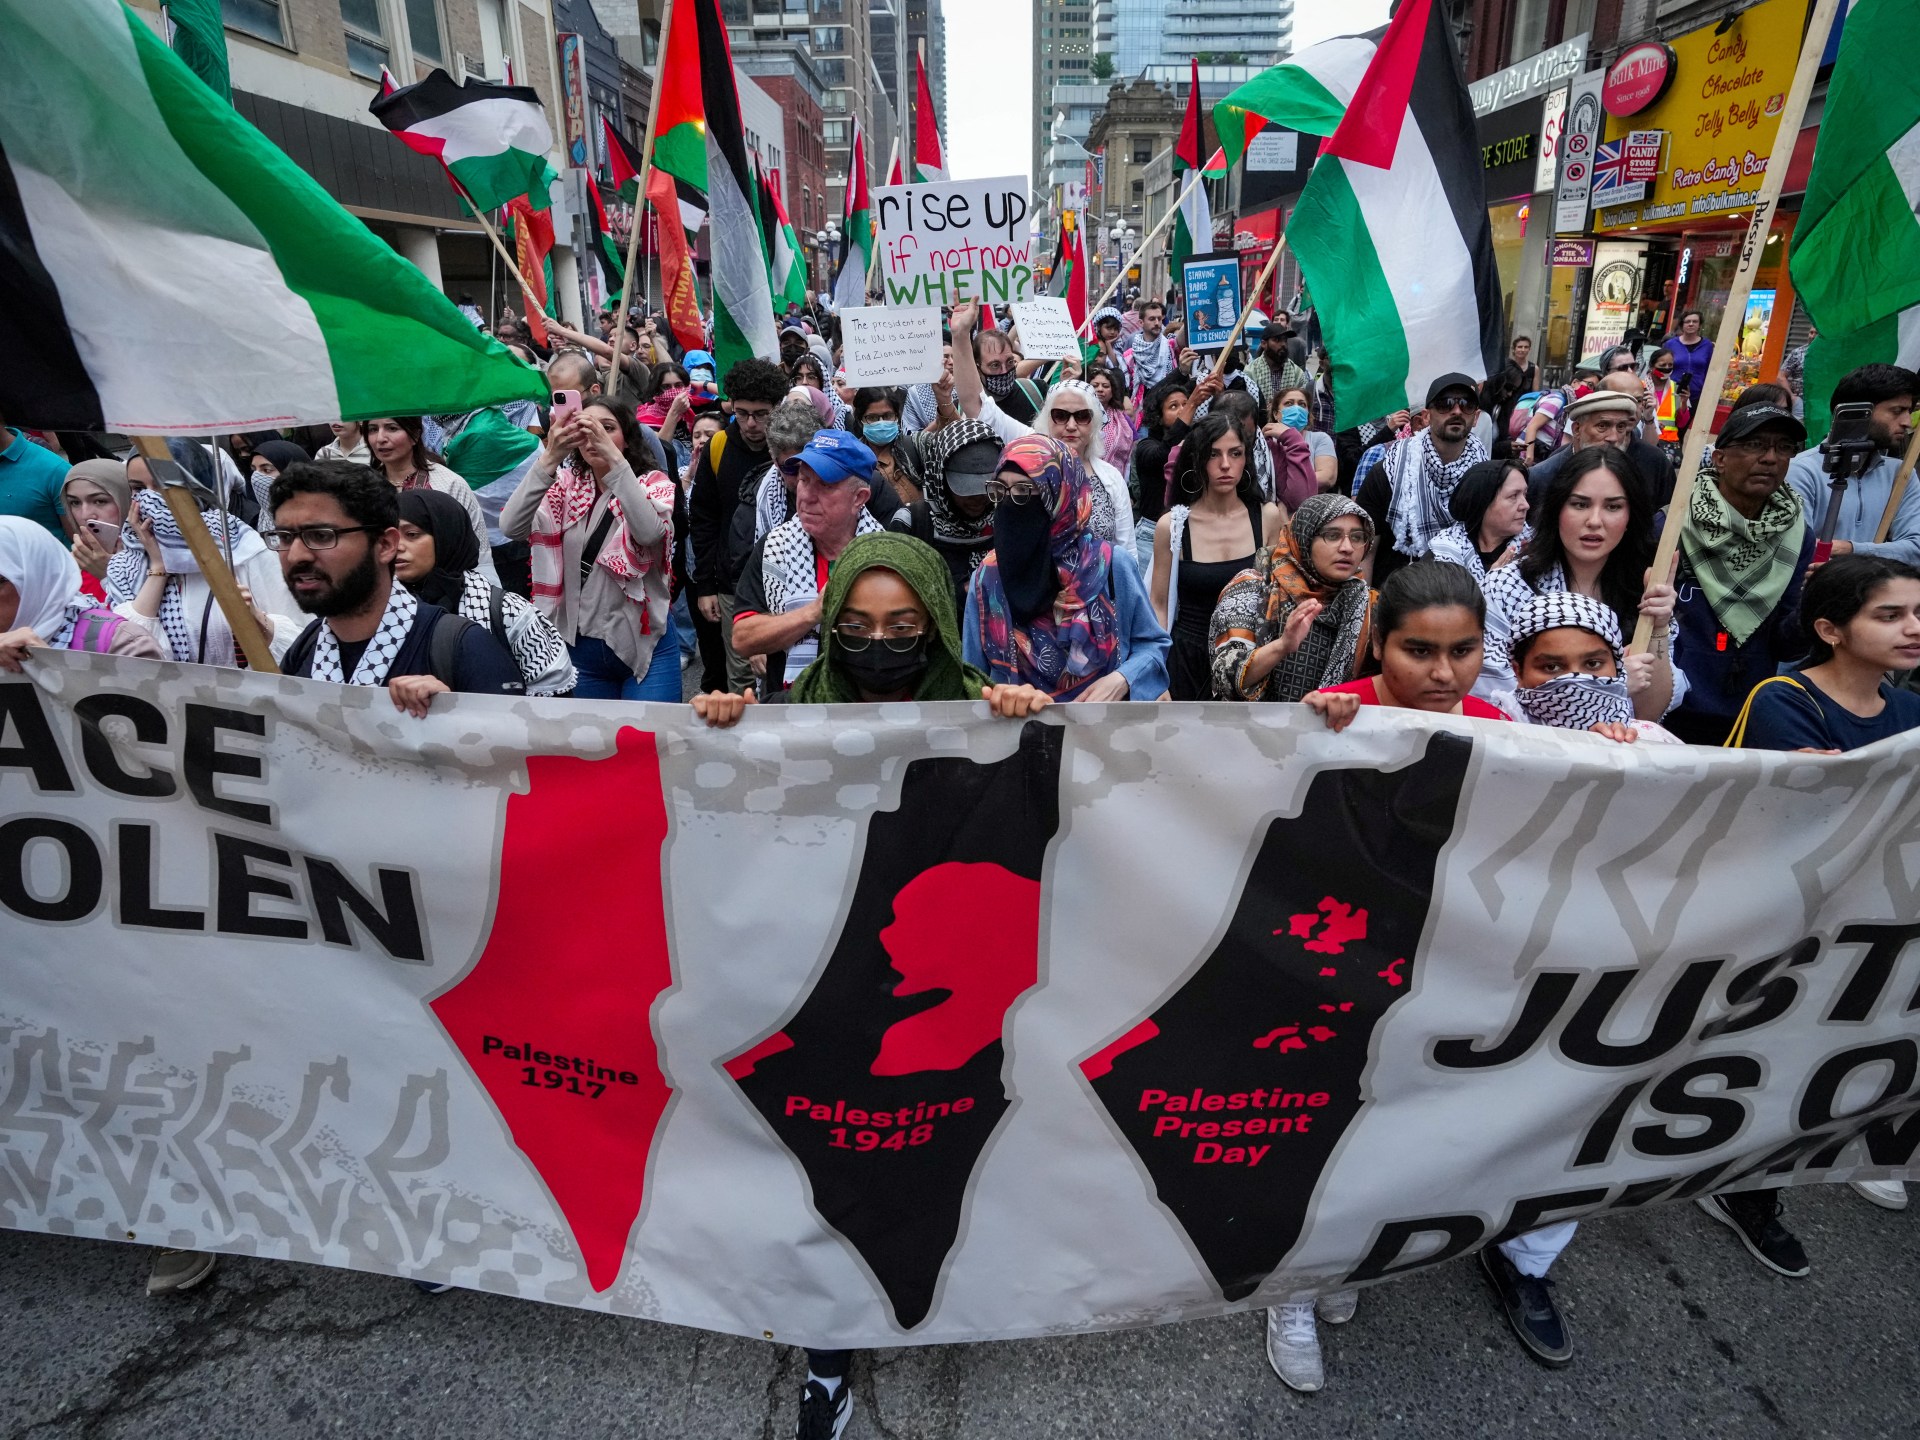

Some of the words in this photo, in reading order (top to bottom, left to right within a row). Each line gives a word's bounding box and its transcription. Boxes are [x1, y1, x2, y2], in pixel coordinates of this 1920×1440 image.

[1707, 34, 1748, 64] Candy
[1608, 66, 1635, 88] Bulk
[1639, 55, 1667, 77] Mine
[1702, 67, 1764, 99] Chocolate
[1616, 90, 1634, 104] Since
[1695, 111, 1724, 138] Jelly
[1728, 99, 1761, 129] Belly
[1494, 133, 1530, 166] STORE
[1629, 147, 1659, 158] CANDY
[1629, 159, 1657, 167] STORE
[1673, 168, 1700, 189] Retro
[1703, 158, 1741, 187] Candy
[878, 190, 970, 232] rise
[984, 192, 1027, 242] up
[1603, 212, 1617, 227] Shop
[1618, 210, 1638, 225] Online
[1642, 201, 1686, 221] bulkmine.com
[888, 234, 918, 274] if
[1121, 242, 1133, 251] 40
[1553, 242, 1586, 256] ONGHAIRS
[1187, 268, 1216, 281] STARVING
[1677, 248, 1690, 284] open
[886, 264, 1032, 306] WHEN?
[1188, 281, 1208, 292] BABIES
[851, 318, 868, 331] The
[872, 318, 914, 332] president
[854, 335, 867, 344] the
[870, 334, 885, 344] UN
[854, 350, 871, 361] End
[873, 349, 907, 360] Zionism
[909, 346, 927, 354] now!
[1583, 336, 1624, 354] LONGHA
[857, 366, 900, 377] Ceasefire
[903, 362, 924, 372] now!
[0, 682, 271, 826] ACE
[0, 817, 425, 961] OLEN
[1432, 923, 1920, 1068] JUST
[481, 1034, 641, 1086] Palestine
[520, 1065, 607, 1100] 1917
[784, 1094, 976, 1130] Palestine
[1137, 1087, 1331, 1114] Palestine
[1572, 1055, 1762, 1168] IS
[827, 1123, 935, 1153] 1948
[1152, 1112, 1313, 1140] Present
[1192, 1141, 1272, 1168] Day
